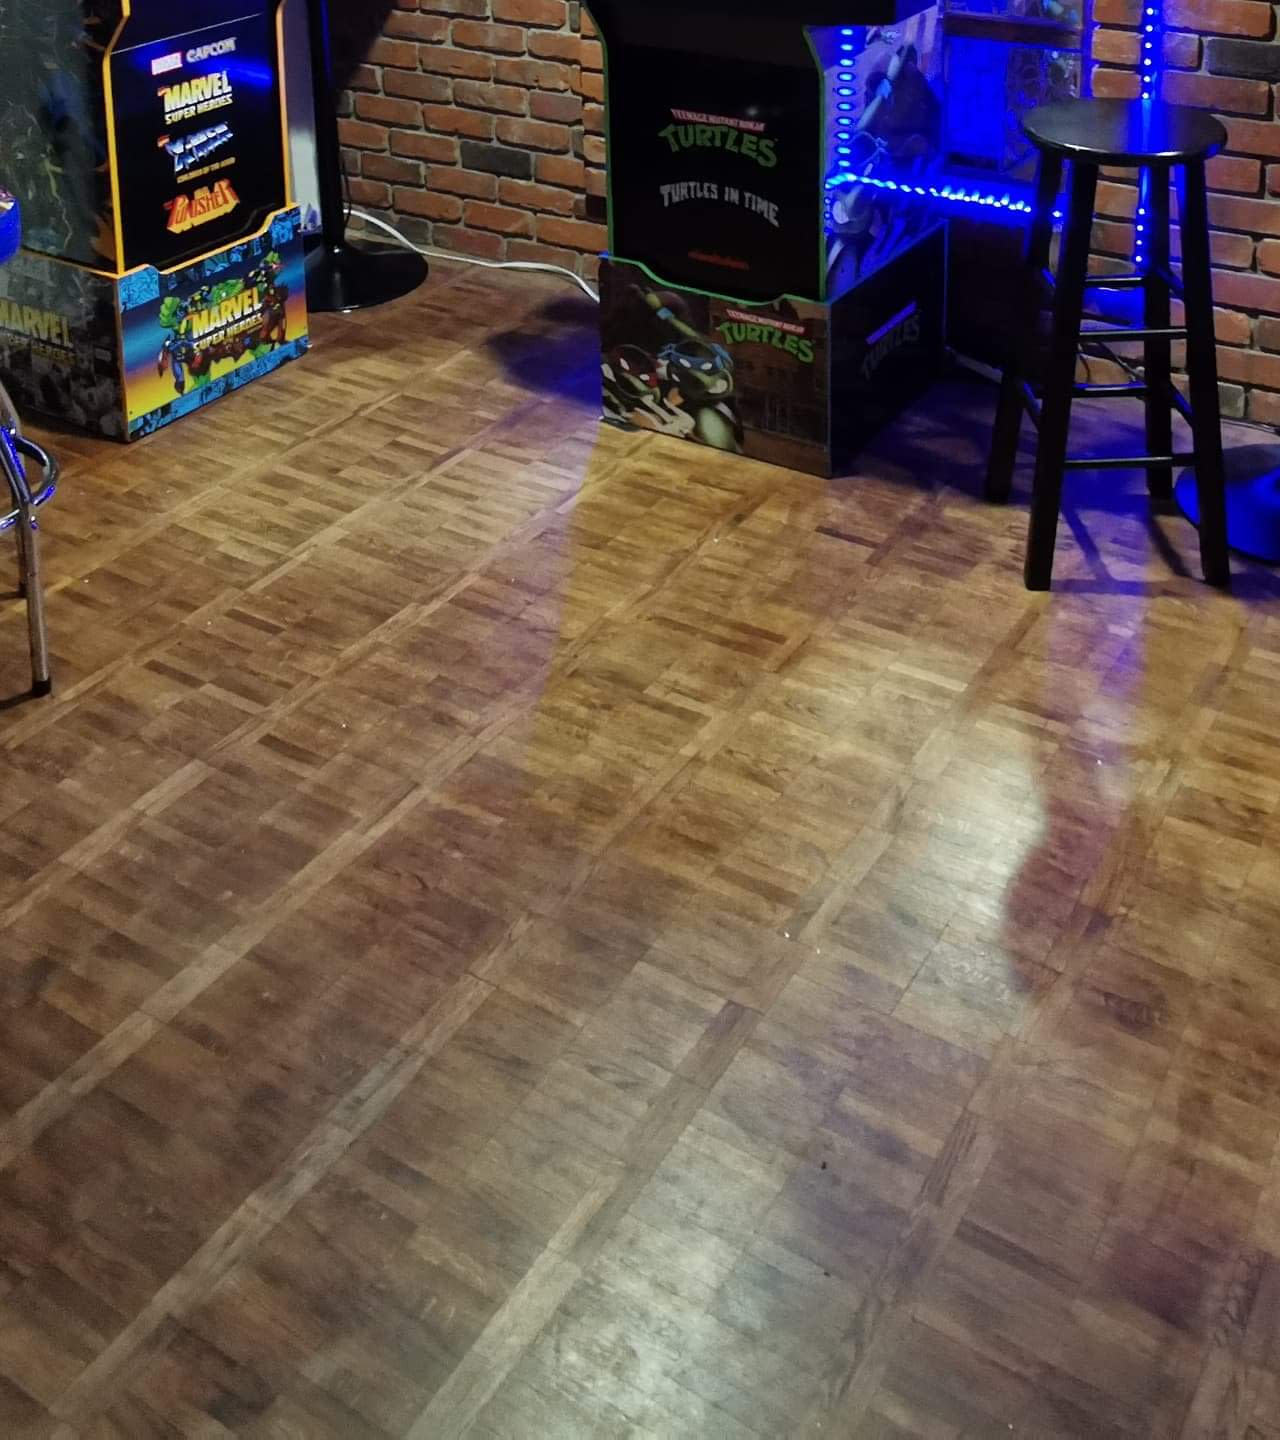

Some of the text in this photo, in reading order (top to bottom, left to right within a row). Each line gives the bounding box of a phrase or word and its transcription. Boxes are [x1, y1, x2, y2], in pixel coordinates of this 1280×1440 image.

[186, 37, 237, 63] CAPCOM
[158, 70, 232, 112] MARVEL
[165, 105, 196, 125] SUPER
[658, 123, 777, 168] TURTLES
[659, 181, 780, 228] TURTLES IN TIME
[187, 287, 262, 339] MARVEL
[193, 334, 225, 352] SUPER
[715, 321, 814, 363] TURTLES
